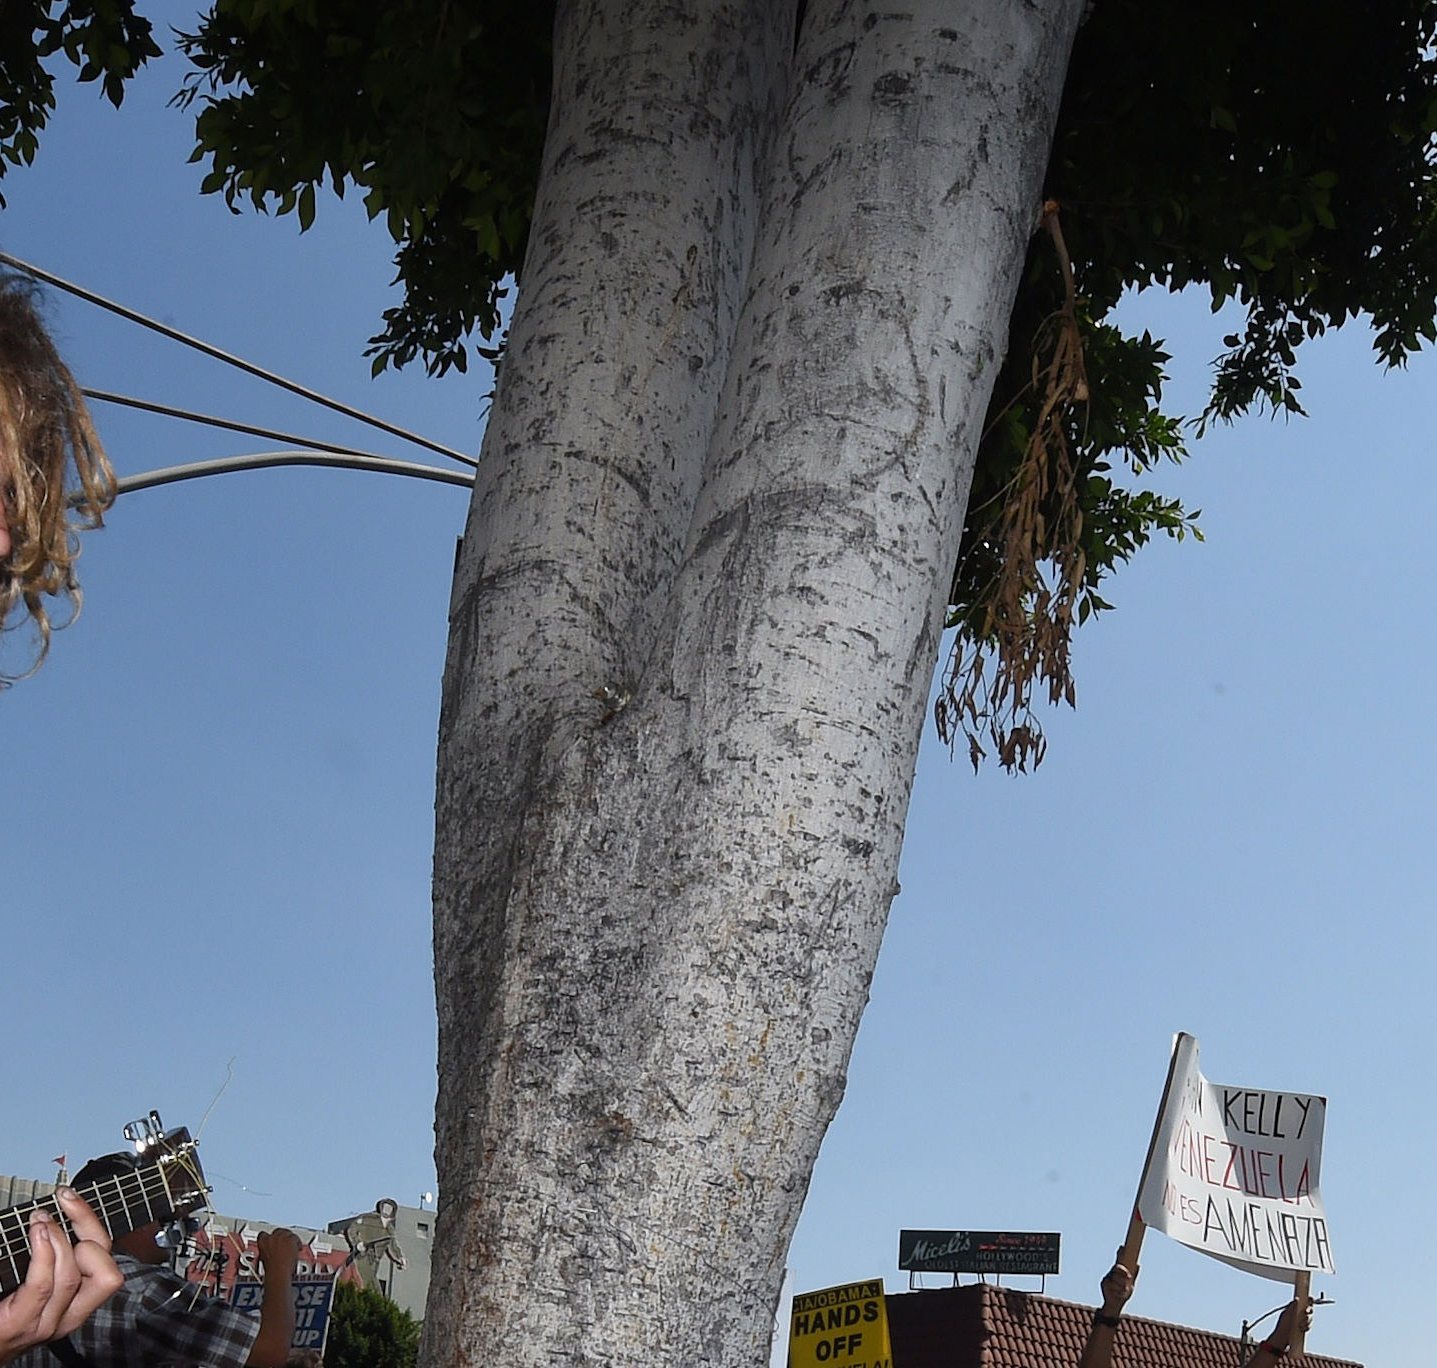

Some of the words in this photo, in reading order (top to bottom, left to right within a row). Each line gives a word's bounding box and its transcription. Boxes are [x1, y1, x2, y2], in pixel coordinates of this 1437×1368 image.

[1224, 1090, 1311, 1139] KELLY
[1180, 1195, 1202, 1224] ES
[1204, 1193, 1335, 1273] AMENAZA
[794, 1301, 879, 1337] HANDS
[816, 1334, 862, 1362] OFF
